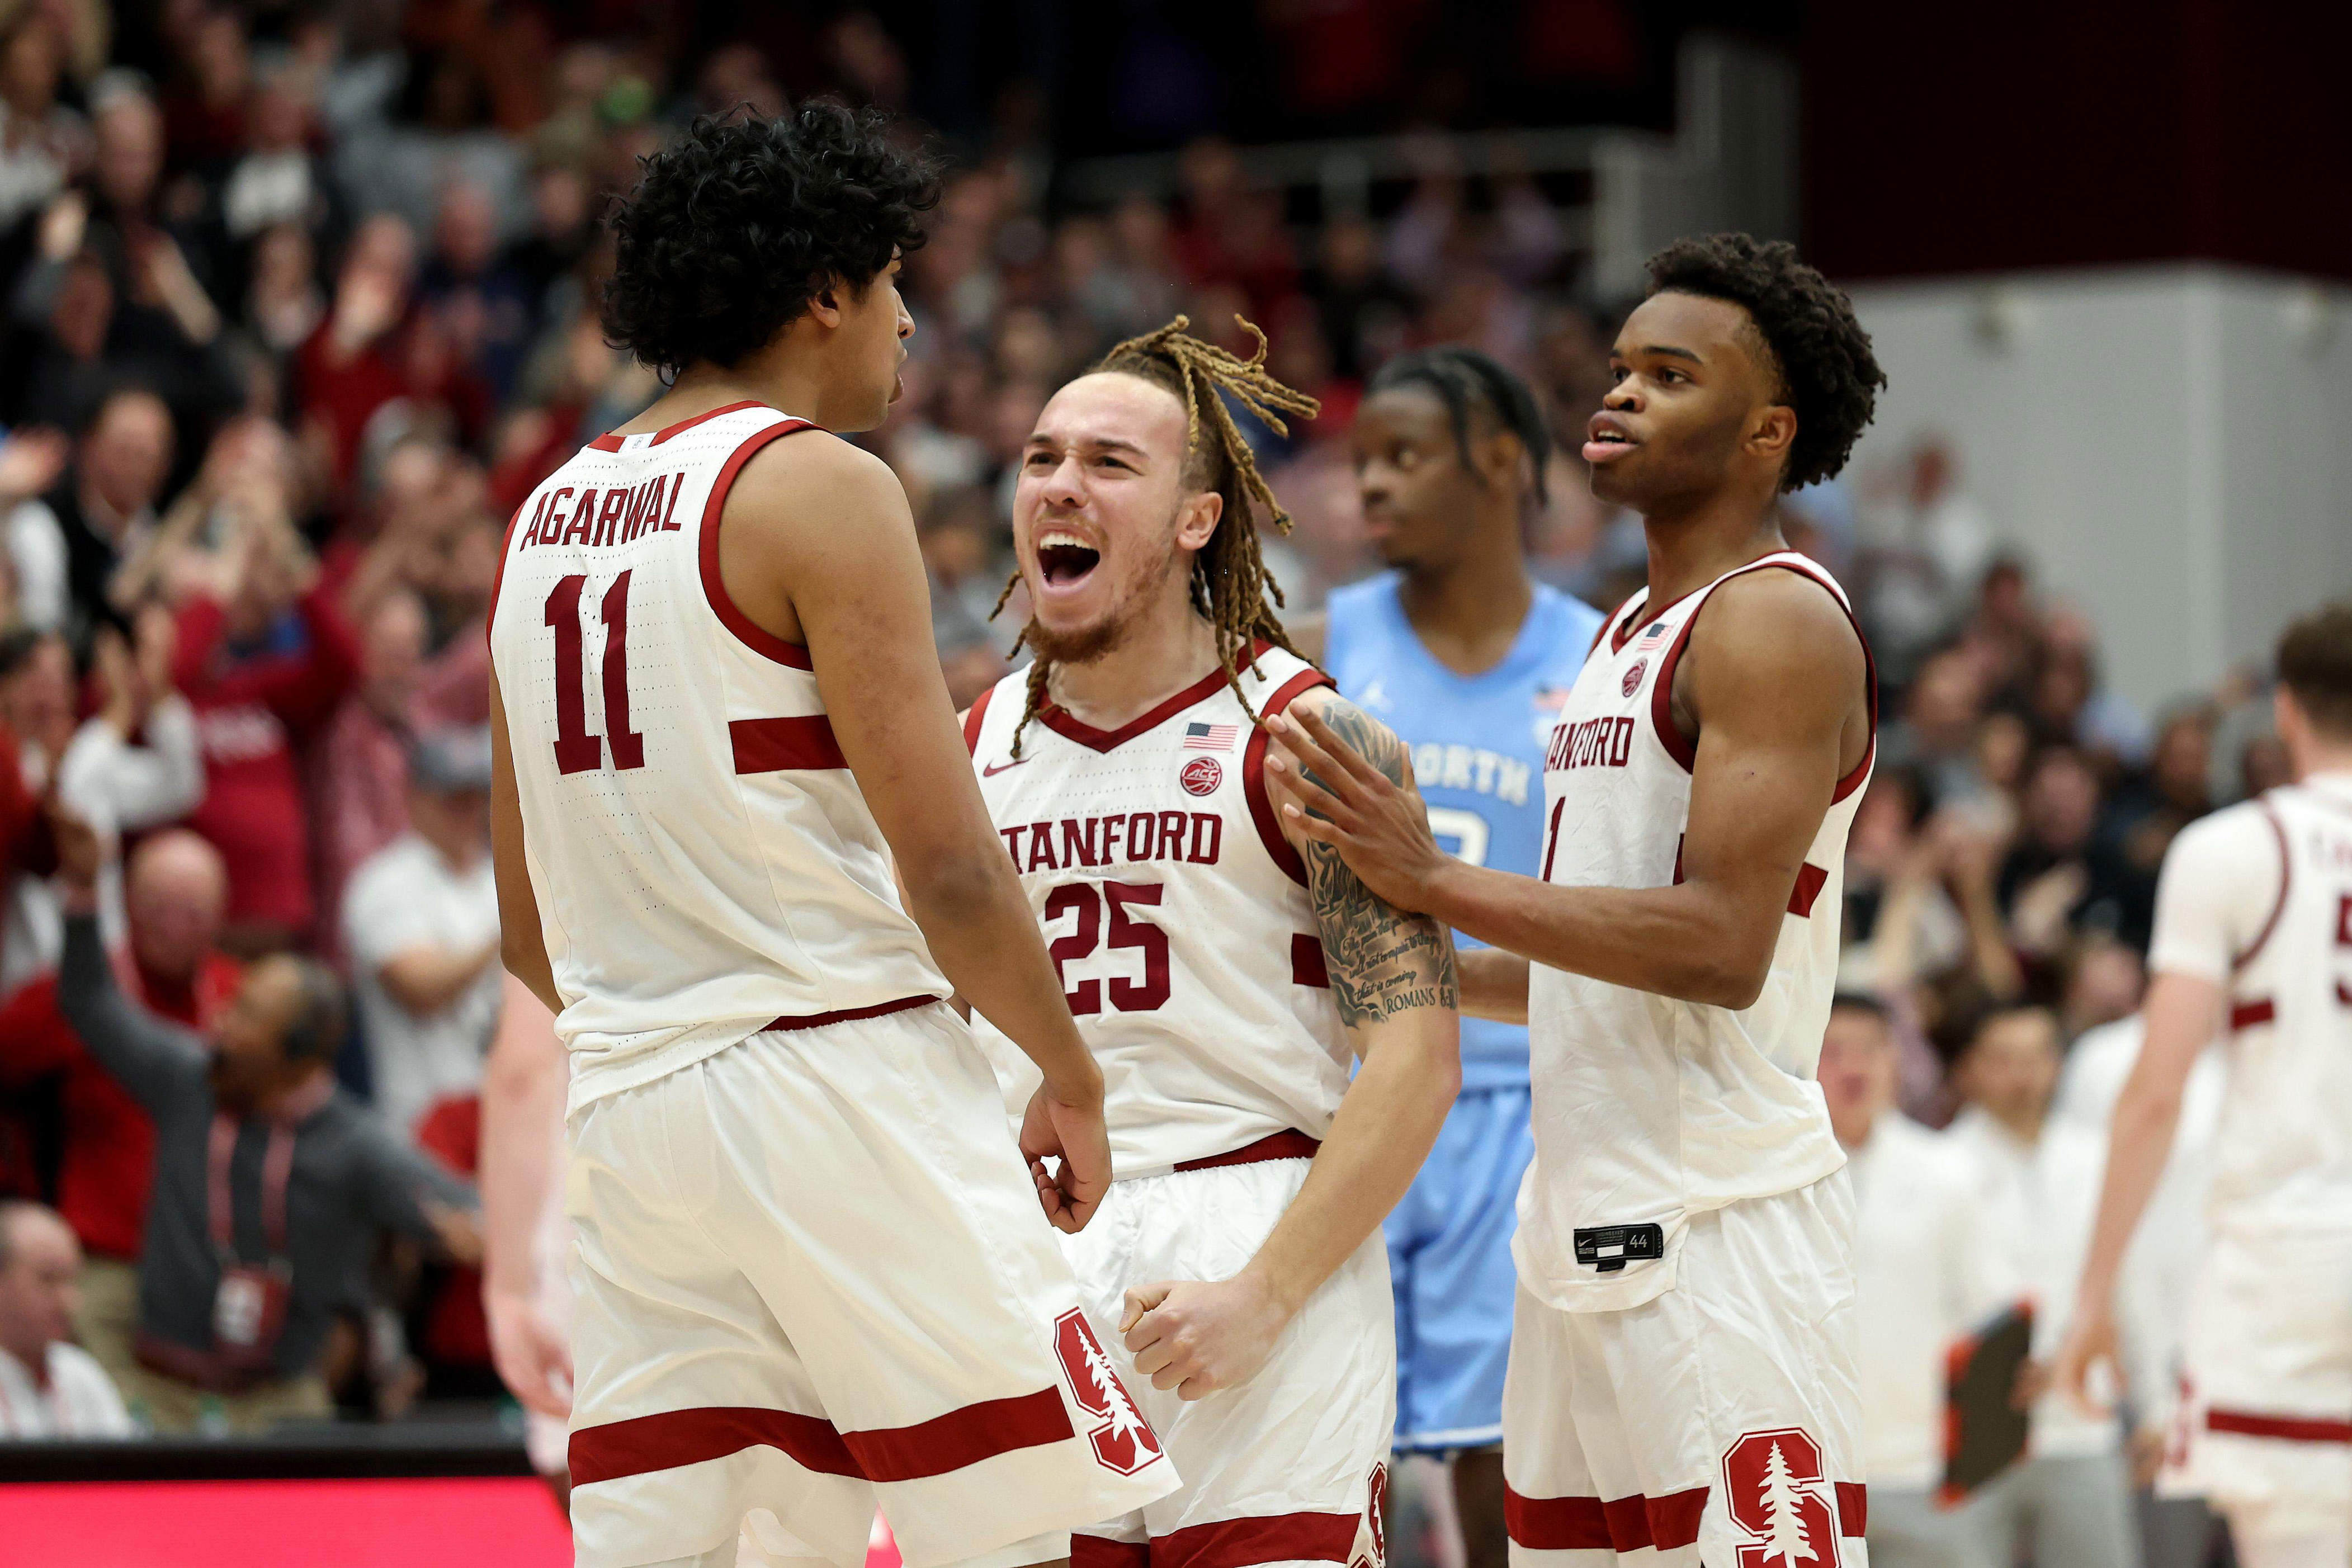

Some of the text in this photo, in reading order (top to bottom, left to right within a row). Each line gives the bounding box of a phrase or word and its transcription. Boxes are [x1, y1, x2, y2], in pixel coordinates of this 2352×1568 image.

[520, 473, 684, 552] AGARWAL
[545, 569, 645, 775] 11
[1184, 768, 1219, 782] ACC
[1409, 743, 1531, 806] ORTH
[1000, 811, 1222, 875] TANFORD
[1045, 880, 1170, 1016] 25
[1385, 987, 1436, 1014] ROMANS
[1629, 1234, 1647, 1248] 44
